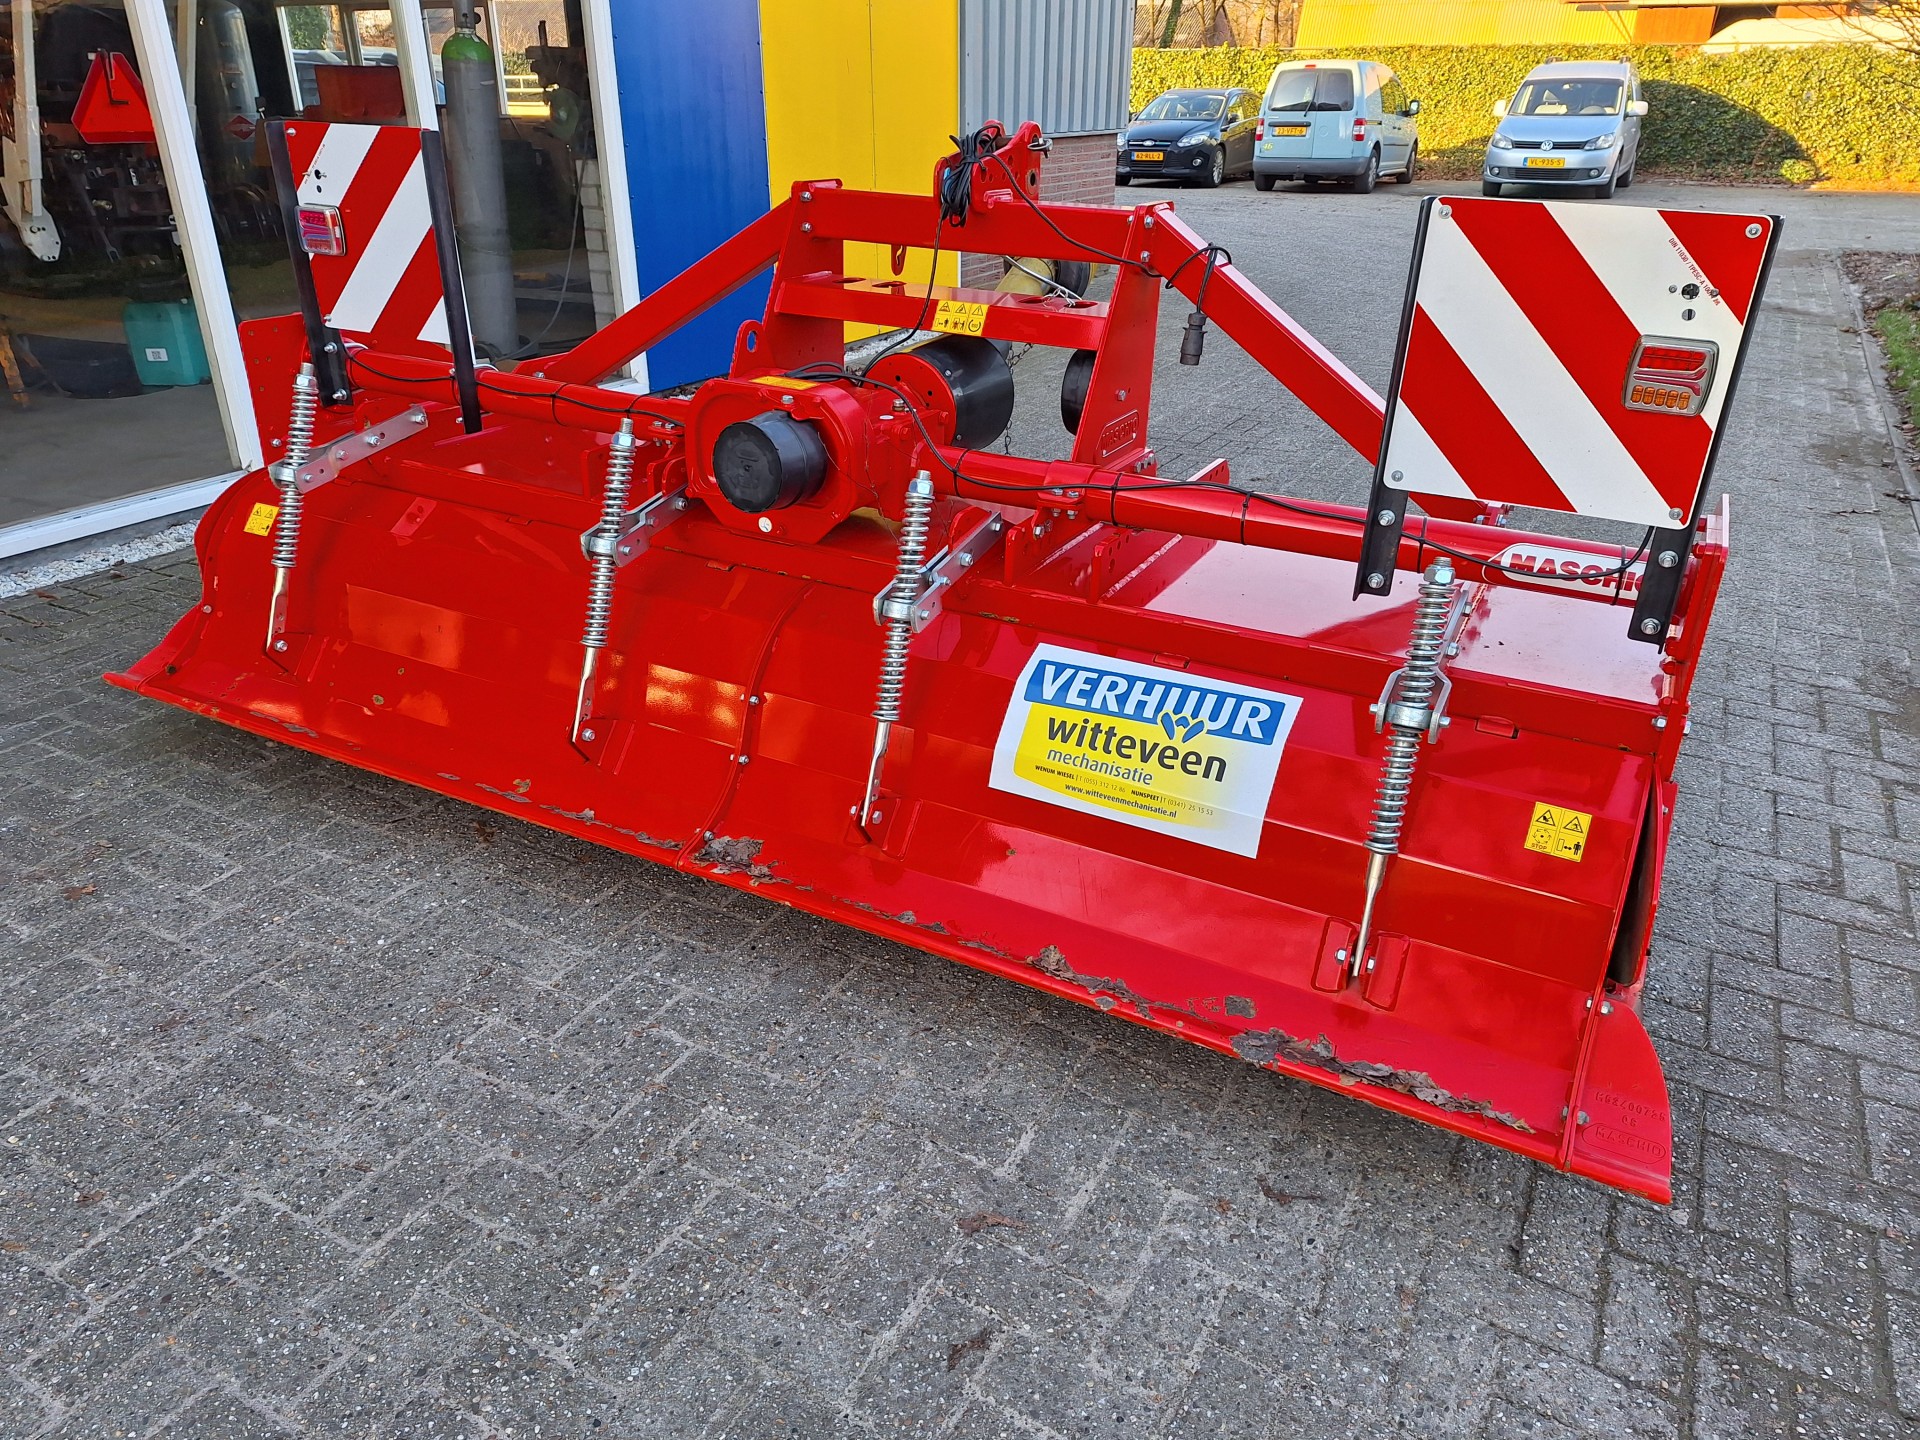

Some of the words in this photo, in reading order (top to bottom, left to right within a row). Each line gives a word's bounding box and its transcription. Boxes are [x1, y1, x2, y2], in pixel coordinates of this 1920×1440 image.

[1530, 158, 1562, 167] VL-935-S
[1509, 553, 1644, 593] MASCHI
[1042, 664, 1272, 739] VERHUUR
[1047, 749, 1153, 785] mechanisatie
[1048, 717, 1227, 782] witteveen
[1035, 765, 1056, 775] WENUM
[1056, 770, 1075, 780] WIESEL
[1083, 777, 1098, 786] (055)
[1131, 789, 1160, 801] NUNSPEET
[1167, 799, 1186, 809] (0341)
[1188, 804, 1196, 812] 25
[1198, 806, 1205, 814] 15
[1206, 808, 1214, 816] 53
[1065, 783, 1177, 818] www.witteveenmechanisatie.nl
[1531, 842, 1548, 850] STOP
